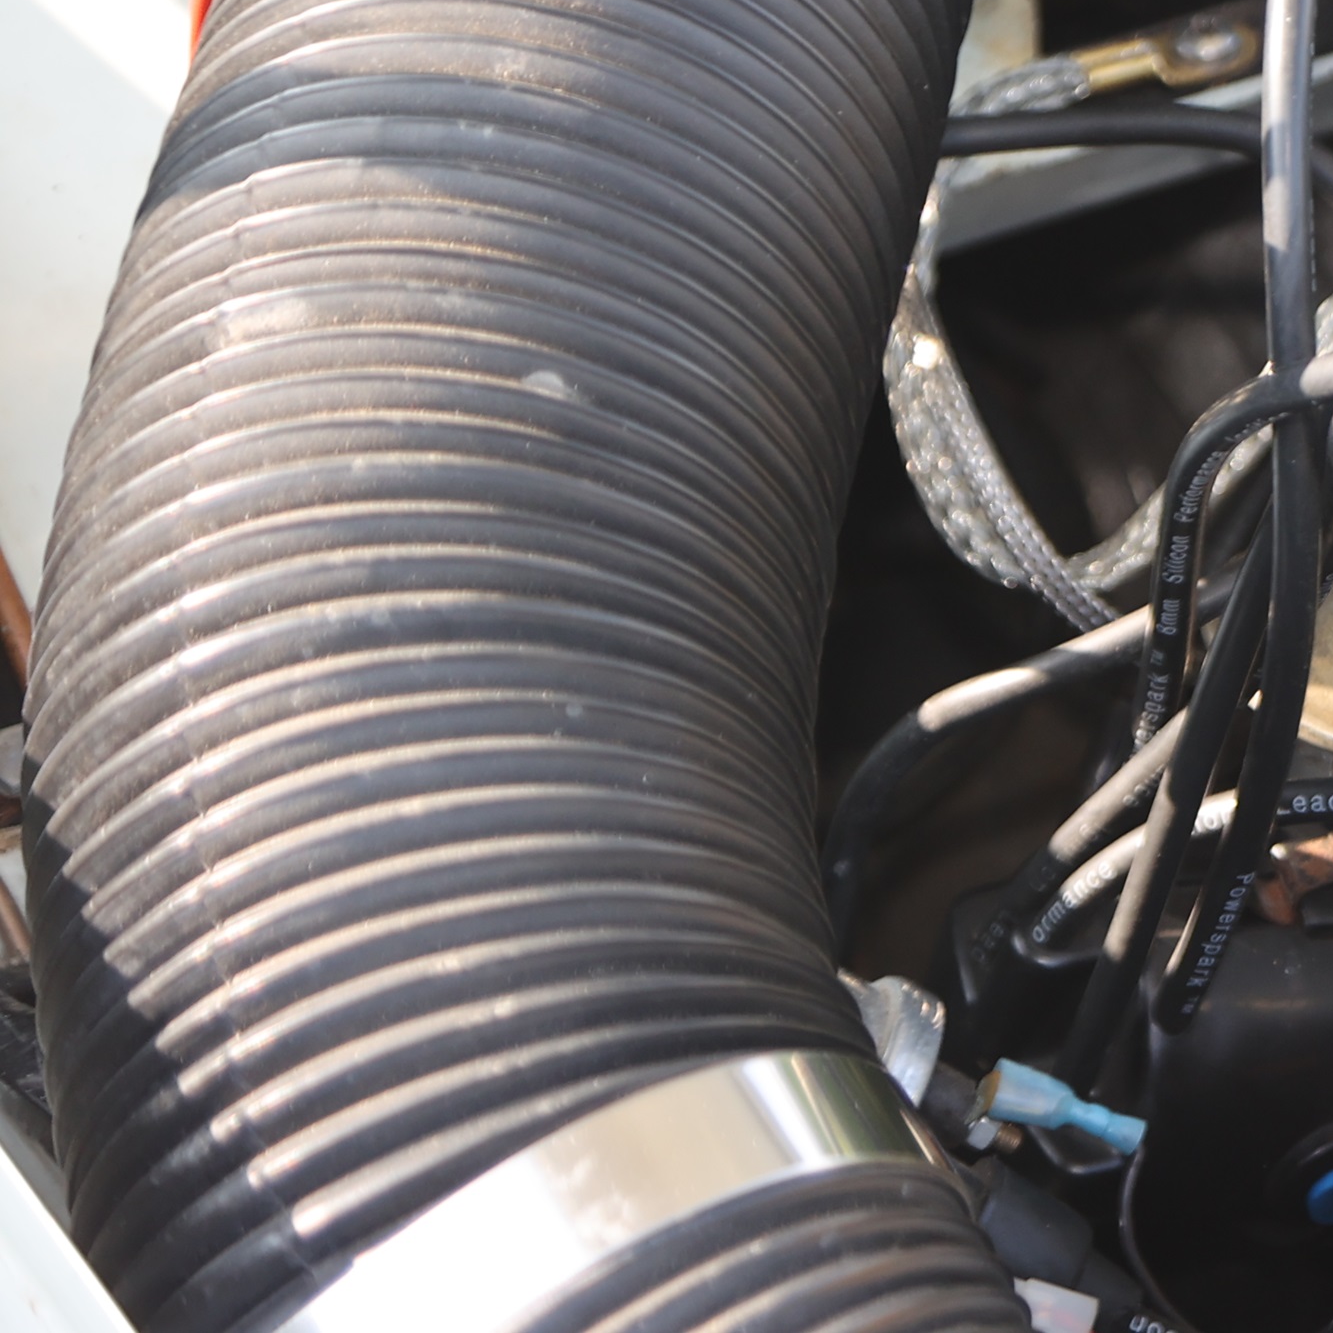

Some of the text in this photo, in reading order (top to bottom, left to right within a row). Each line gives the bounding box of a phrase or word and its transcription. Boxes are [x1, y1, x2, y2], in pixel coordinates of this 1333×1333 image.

[1162, 535, 1190, 584] Silicon
[1156, 598, 1181, 635] 8mm
[1186, 872, 1255, 987] Powerspark
